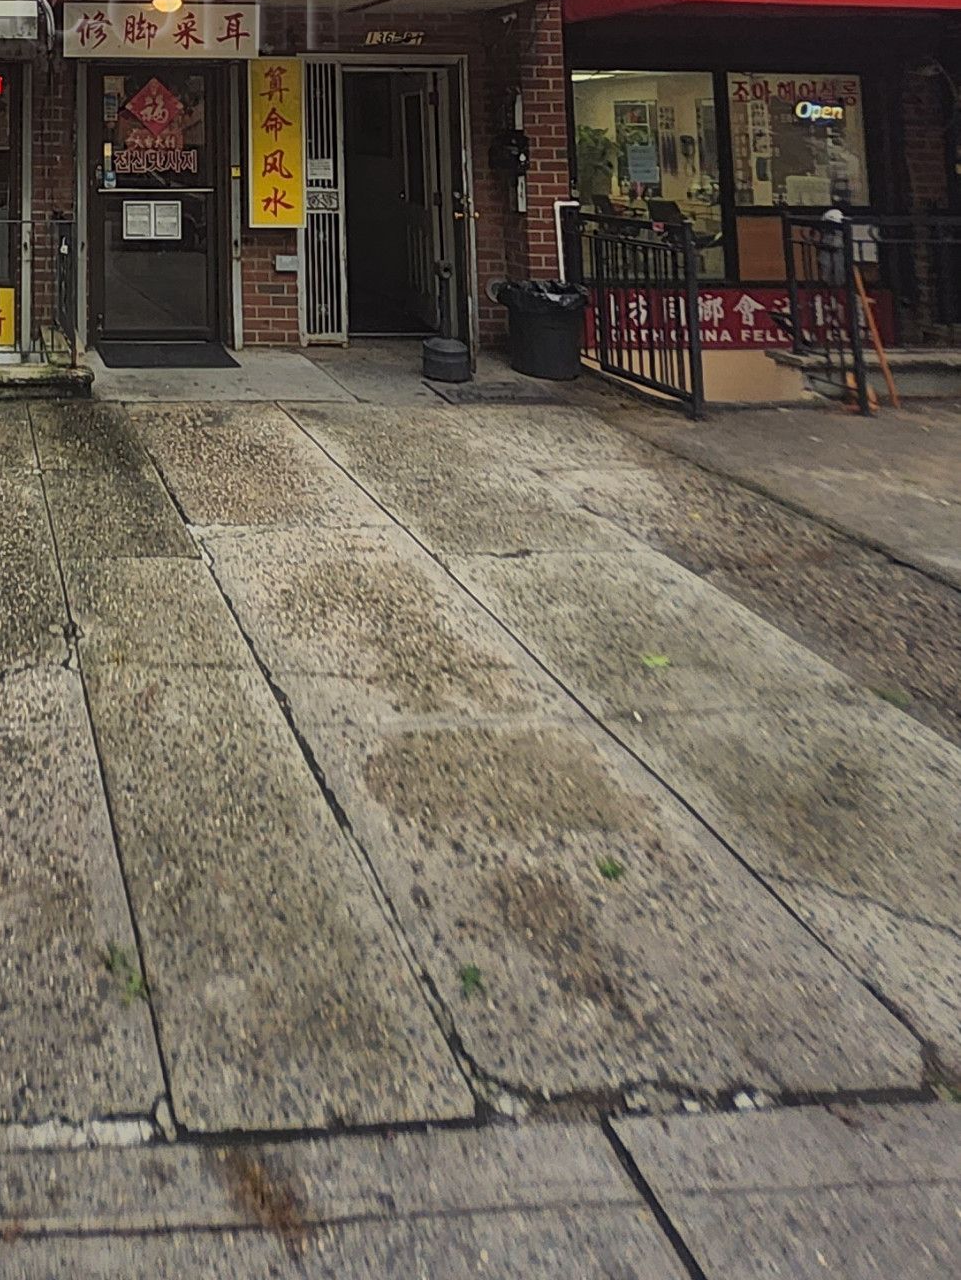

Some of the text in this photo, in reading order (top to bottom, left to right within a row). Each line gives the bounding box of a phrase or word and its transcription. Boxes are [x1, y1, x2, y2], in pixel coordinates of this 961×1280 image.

[76, 10, 251, 51] 修脚采耳
[795, 101, 844, 121] Open
[260, 65, 295, 218] 算命风水
